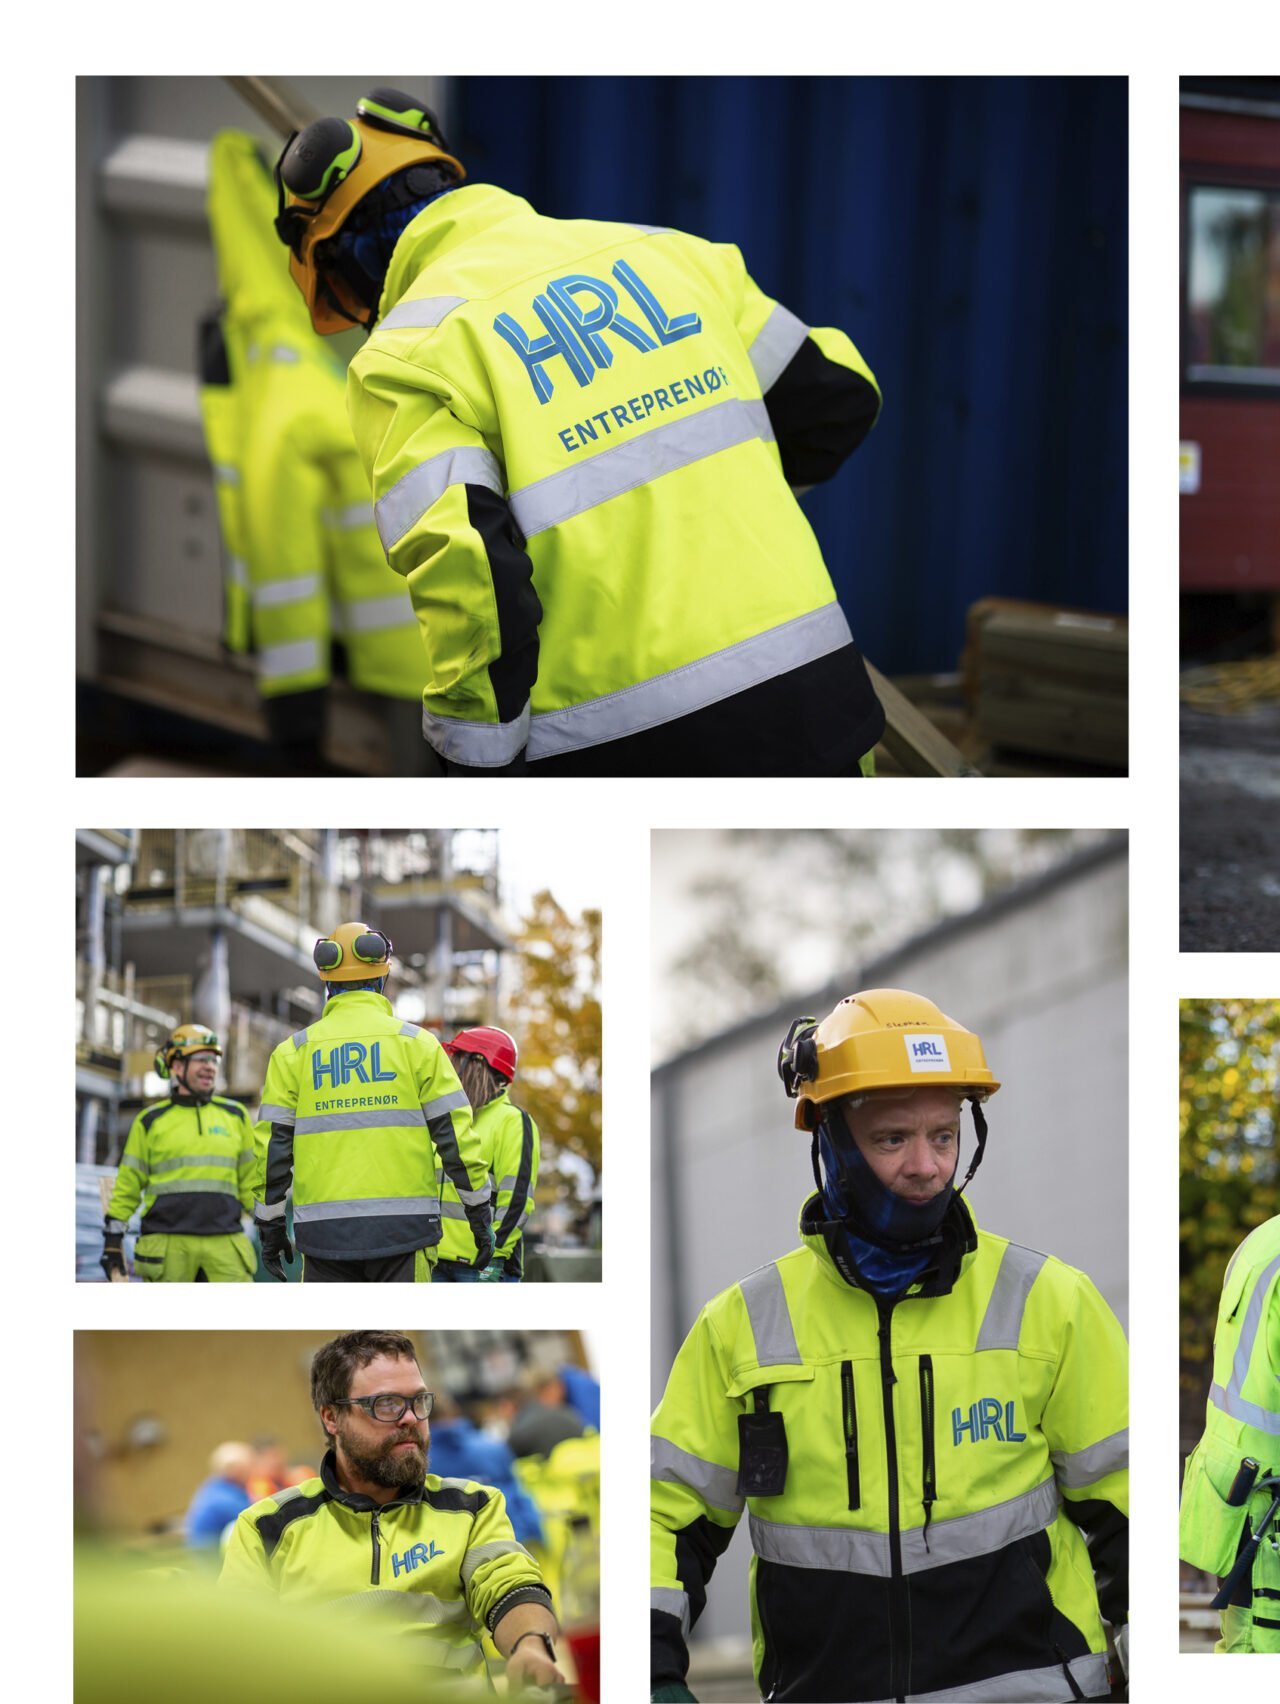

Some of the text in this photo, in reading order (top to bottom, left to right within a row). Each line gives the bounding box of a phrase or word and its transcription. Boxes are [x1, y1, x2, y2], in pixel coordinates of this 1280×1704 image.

[493, 259, 702, 405] HRL
[312, 1042, 397, 1091] HRL
[912, 1041, 942, 1056] HRL
[315, 1095, 399, 1111] ENTREPRENØR
[951, 1397, 1027, 1447] HRL
[391, 1540, 445, 1578] HRL
